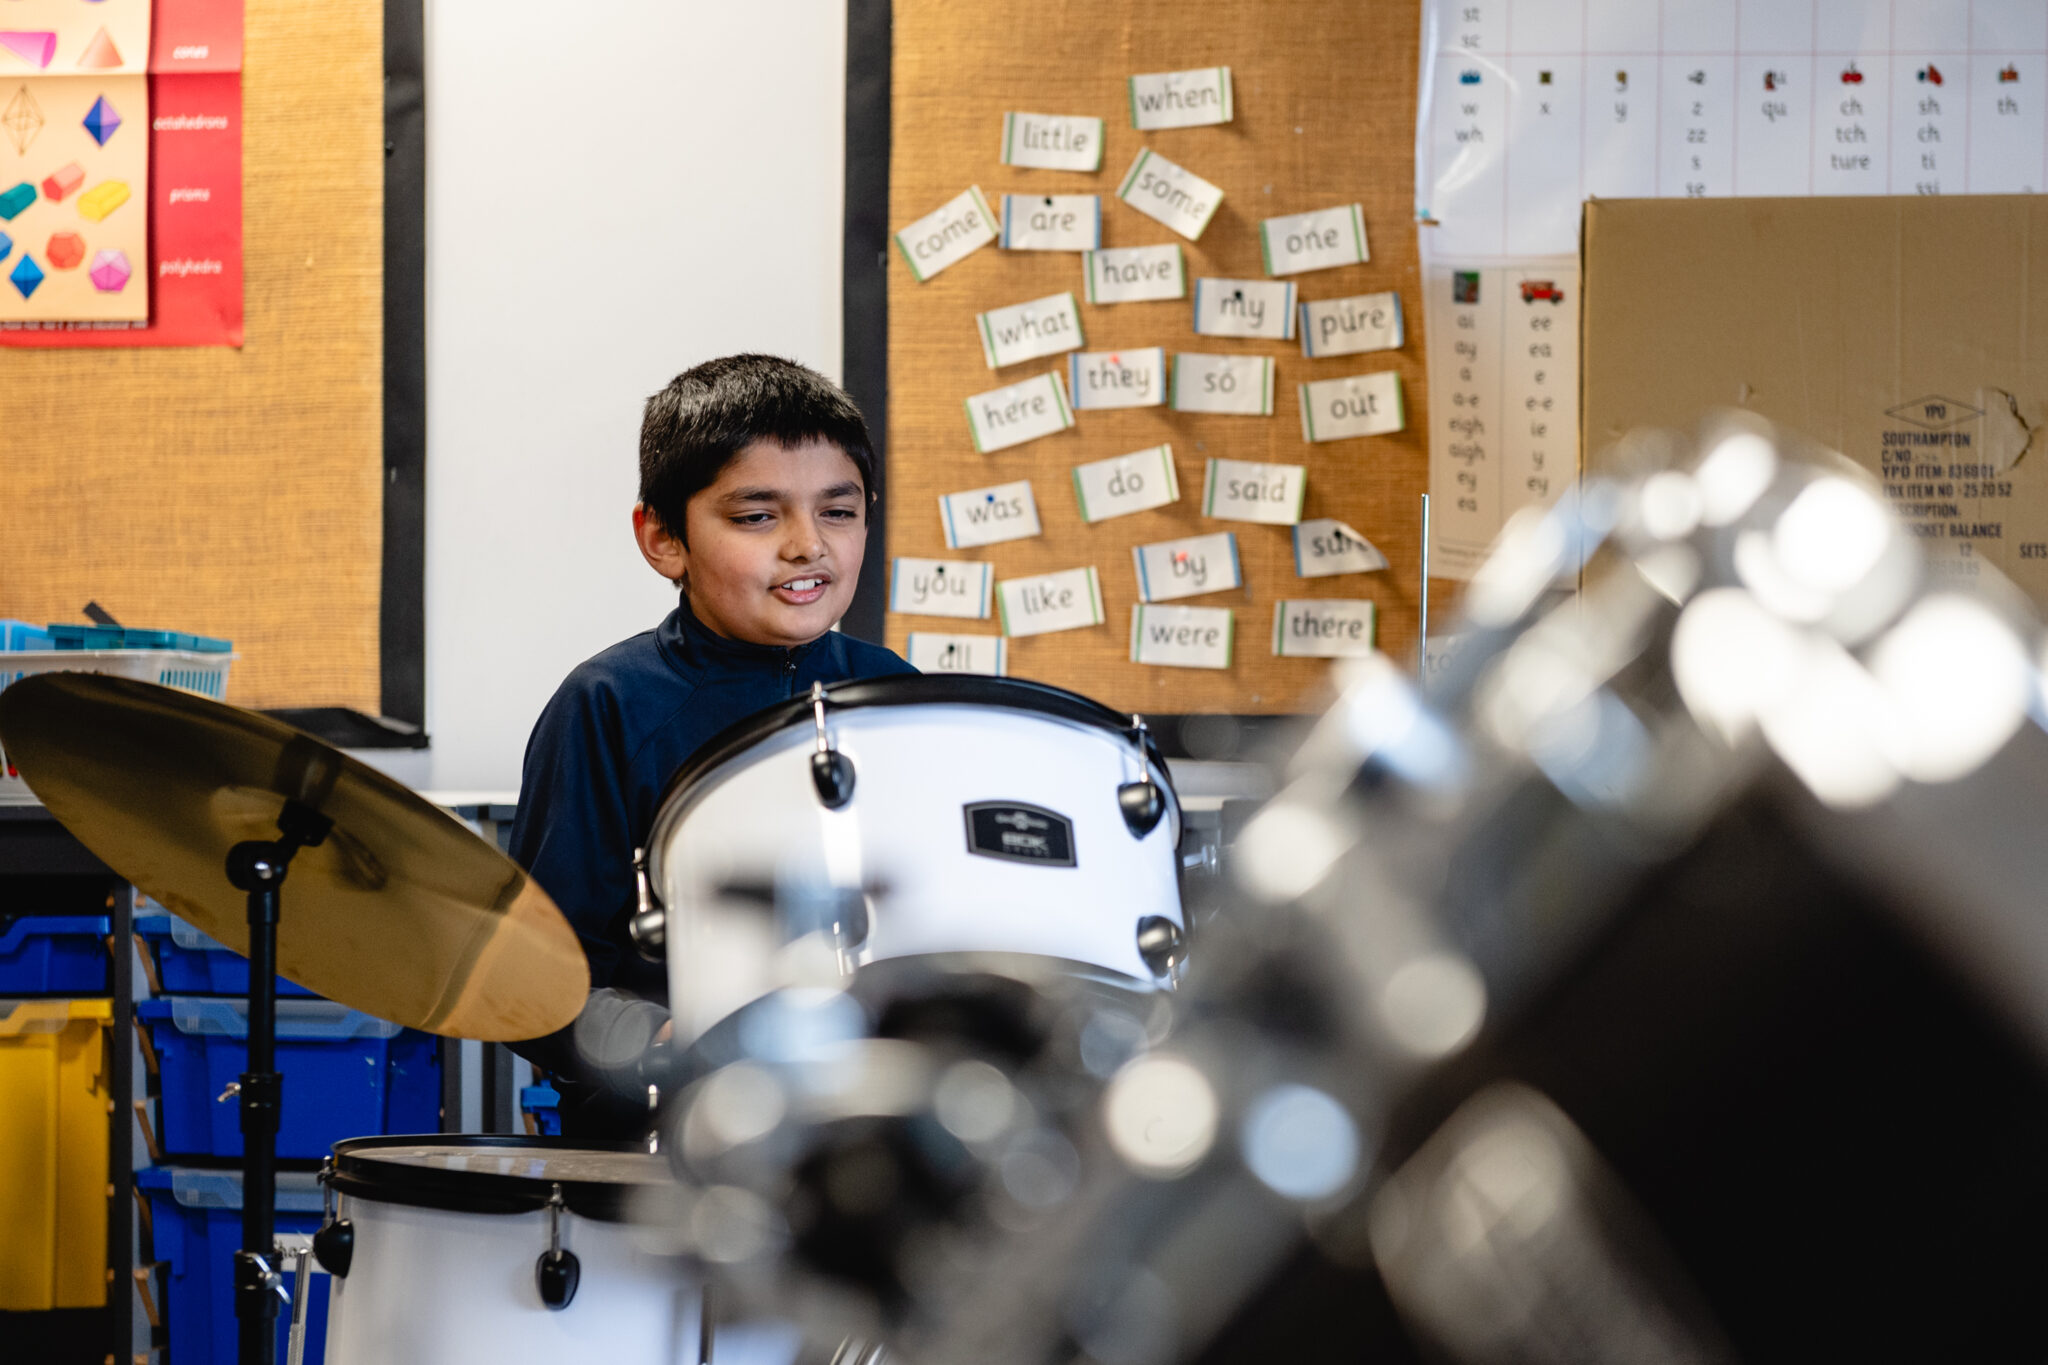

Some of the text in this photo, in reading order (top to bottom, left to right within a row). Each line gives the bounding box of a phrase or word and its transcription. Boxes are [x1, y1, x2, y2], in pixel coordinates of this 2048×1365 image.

[1138, 83, 1218, 112] when
[1840, 97, 1863, 116] ch
[1919, 97, 1941, 116] sh
[1997, 96, 2019, 116] th
[153, 115, 228, 131] octahedrons
[1761, 101, 1787, 122] qu
[1022, 120, 1088, 152] little
[1835, 125, 1867, 144] tch
[1917, 125, 1941, 143] ch
[1831, 153, 1870, 171] ture
[1921, 153, 1936, 170] ti
[169, 187, 210, 204] prisms
[1139, 172, 1207, 219] some
[914, 210, 981, 260] come
[1030, 211, 1076, 233] are
[1286, 228, 1339, 254] one
[159, 258, 222, 276] polyhedra
[1102, 256, 1172, 284] have
[1220, 297, 1265, 329] my
[997, 312, 1071, 347] what
[1320, 309, 1385, 346] pure
[1088, 361, 1151, 397] they
[1203, 372, 1236, 393] so
[984, 395, 1047, 429] here
[1330, 393, 1378, 420] out
[1881, 432, 1971, 448] SOUTHAMPTON
[1108, 468, 1144, 497] do
[1882, 464, 1911, 480] YPO
[1228, 475, 1287, 502] said
[1907, 483, 1934, 498] ITEM
[966, 496, 1023, 525] was
[1950, 523, 2003, 538] BALANCE
[2019, 543, 2048, 559] SETS
[1170, 550, 1207, 586] by
[913, 574, 966, 604] you
[1021, 586, 1073, 616] like
[1150, 625, 1219, 647] were
[1292, 610, 1363, 640] there
[938, 643, 971, 671] all
